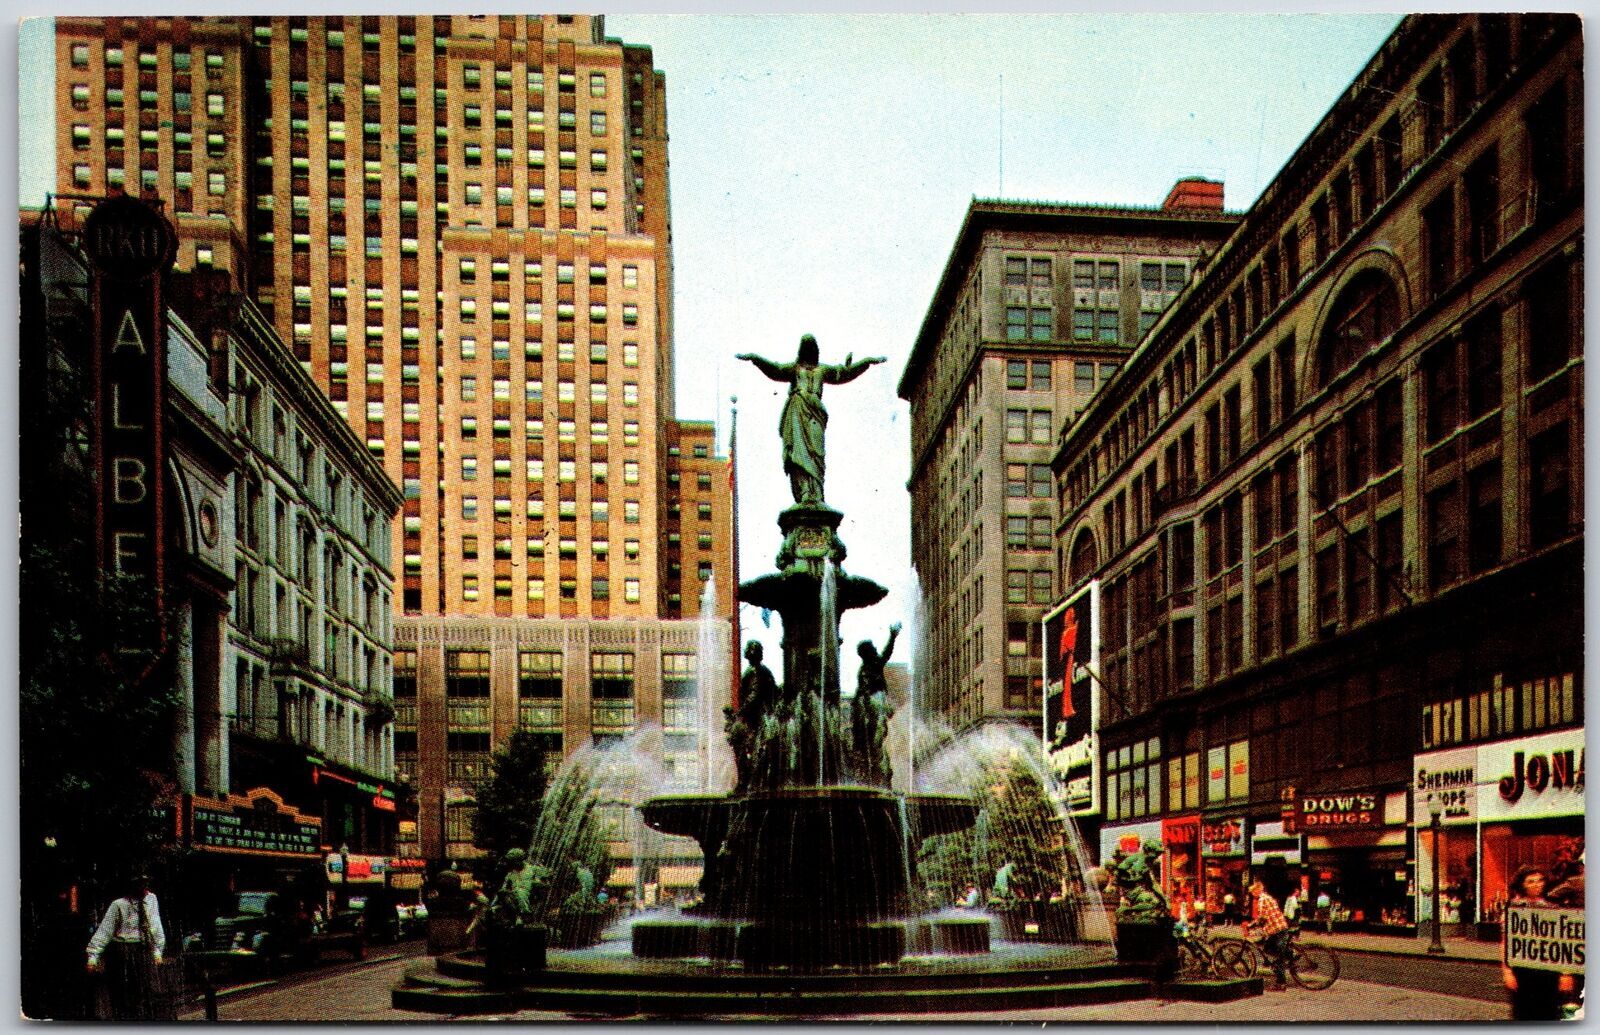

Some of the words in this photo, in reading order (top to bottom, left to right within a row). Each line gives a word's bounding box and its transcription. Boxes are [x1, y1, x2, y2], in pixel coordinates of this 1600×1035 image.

[1303, 795, 1375, 813] DOW'S
[1427, 789, 1466, 806] OPS
[1306, 812, 1371, 825] DRUGS
[1511, 911, 1528, 935] DO
[1531, 912, 1557, 937] NOT
[1560, 914, 1585, 939] FEE
[1511, 937, 1585, 965] PIGEONS
